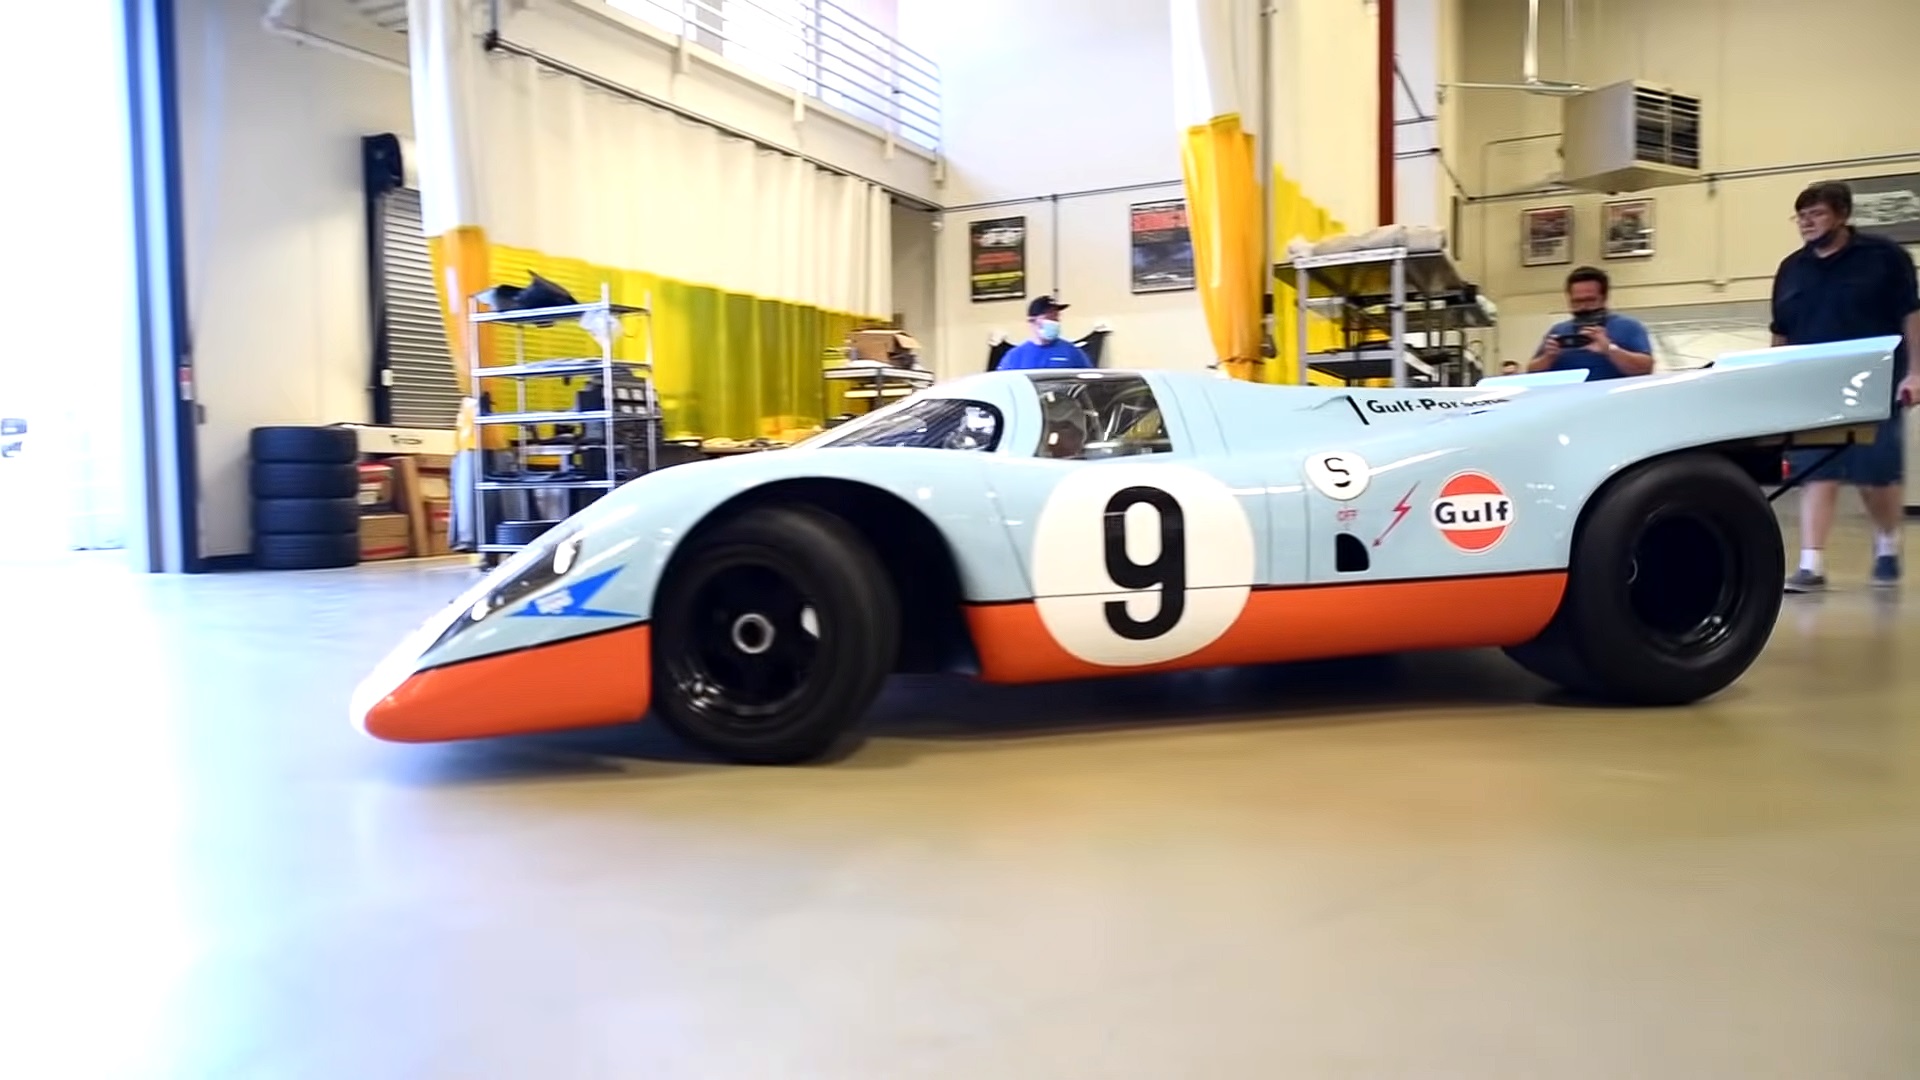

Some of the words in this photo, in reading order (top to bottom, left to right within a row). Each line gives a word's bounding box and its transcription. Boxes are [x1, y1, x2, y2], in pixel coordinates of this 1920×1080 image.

[1366, 398, 1510, 414] Gulf-Porsch
[1324, 457, 1351, 488] S
[1434, 501, 1509, 524] Gulf
[1104, 485, 1185, 640] 9
